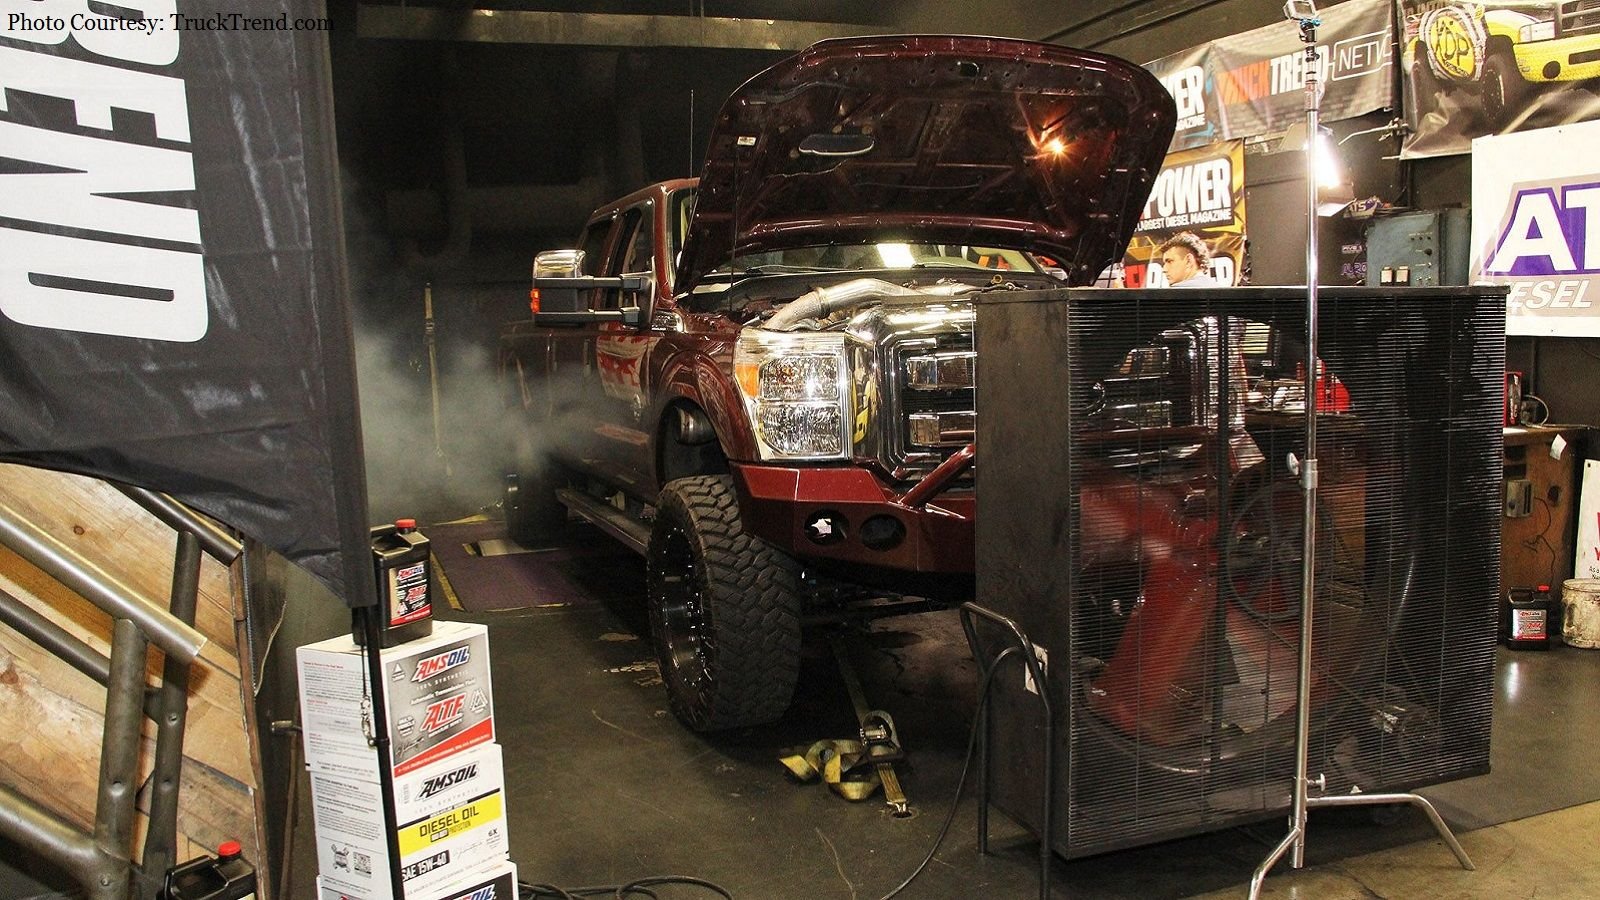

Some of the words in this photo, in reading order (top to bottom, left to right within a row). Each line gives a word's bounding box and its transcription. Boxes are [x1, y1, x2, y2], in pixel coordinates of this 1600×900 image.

[1143, 158, 1231, 220] POWER
[1190, 208, 1232, 224] MAGAZINE
[412, 646, 470, 681] AMSOIL
[419, 763, 477, 799] AMSOIL
[419, 814, 460, 838] DIESEL
[462, 806, 480, 821] OIL
[401, 864, 417, 882] SAE
[418, 852, 447, 874] 15W-40
